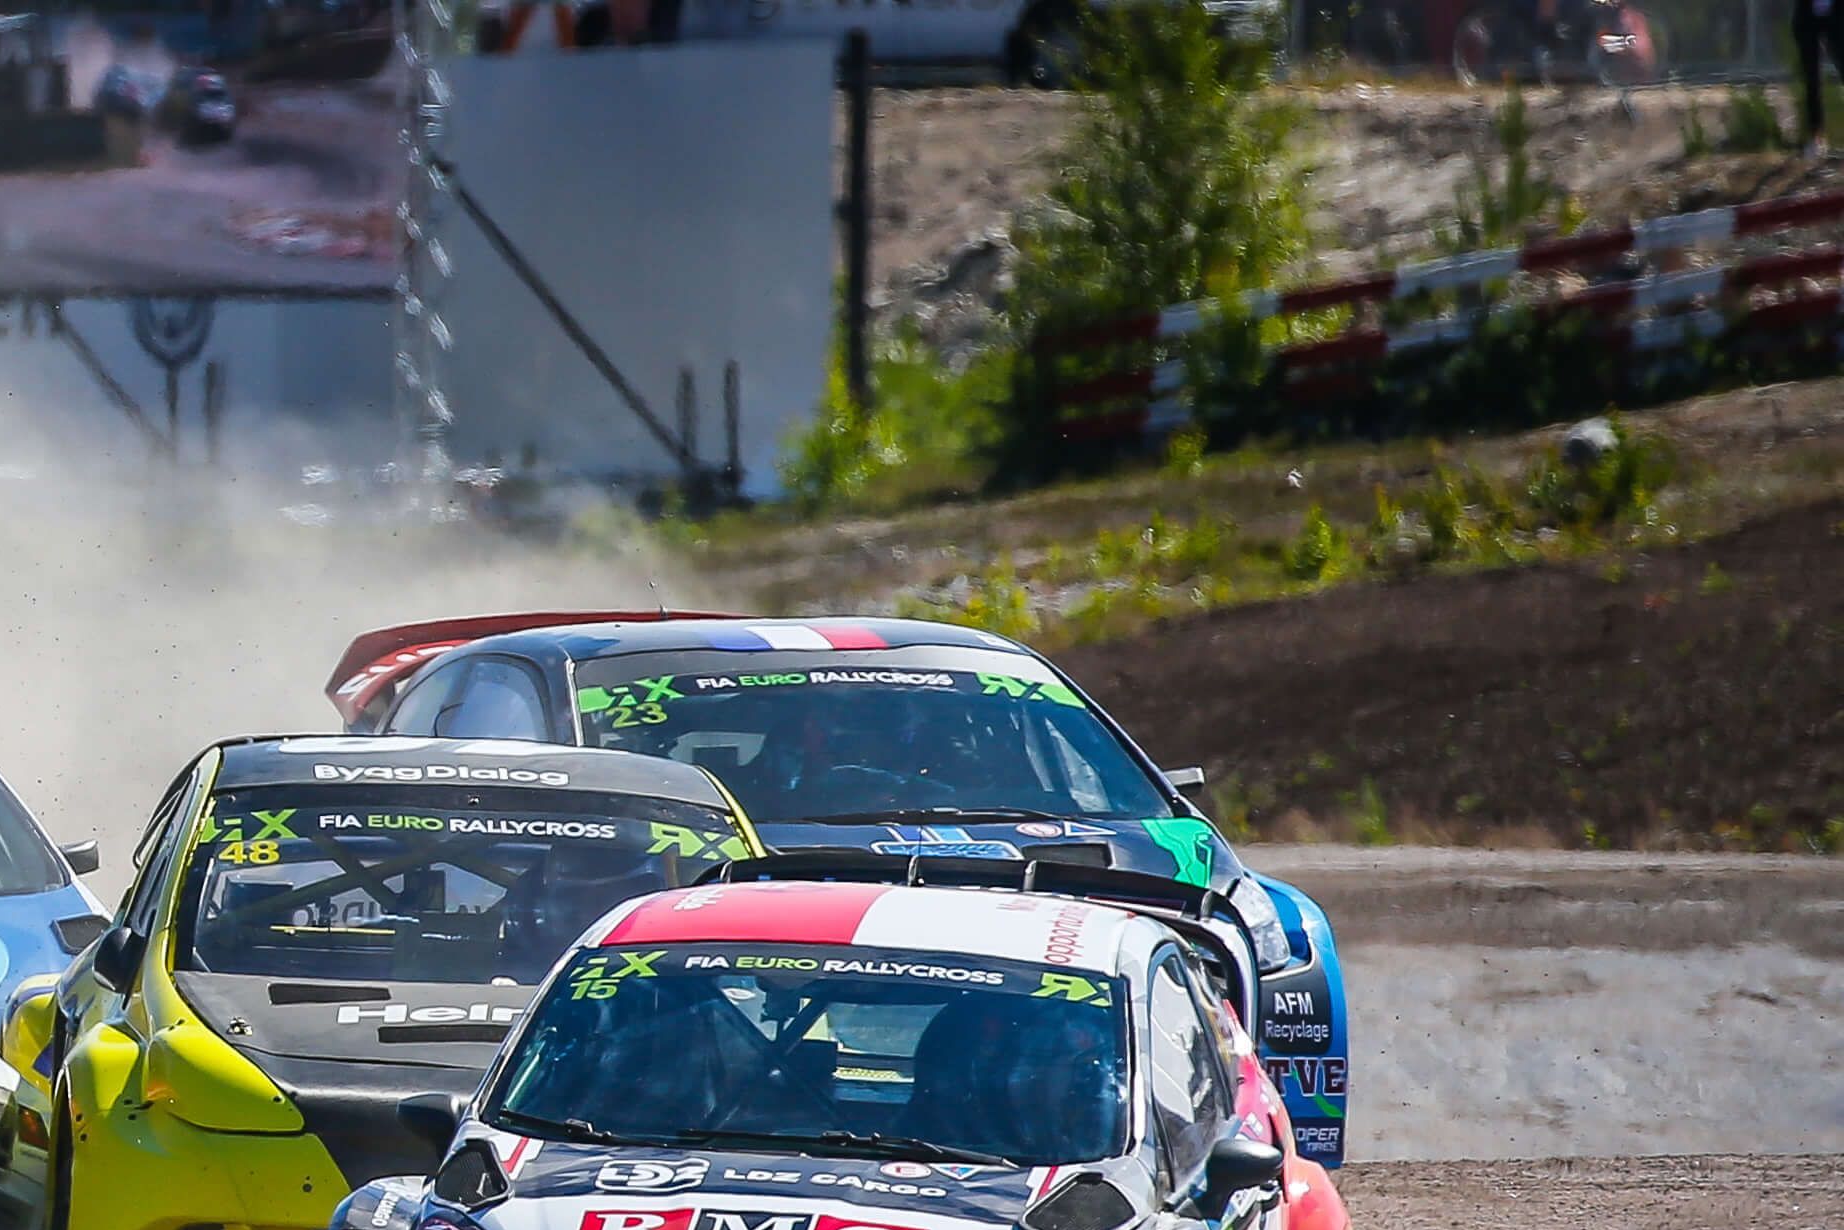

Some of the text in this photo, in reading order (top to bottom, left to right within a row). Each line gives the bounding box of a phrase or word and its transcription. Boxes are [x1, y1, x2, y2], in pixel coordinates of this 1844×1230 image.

[696, 670, 955, 690] FIA EURO RALLYCROSS
[605, 702, 669, 729] 23
[318, 813, 617, 840] FIA EURO RALLYCROSS
[218, 840, 281, 865] 48
[685, 955, 1006, 986] FIA EURO RALLYCROSS
[570, 979, 621, 1001] 15
[1273, 990, 1315, 1017] AFM
[1264, 1019, 1331, 1043] Recyclage
[1295, 1127, 1341, 1142] OPER
[723, 1168, 948, 1198] LDZ CARGO
